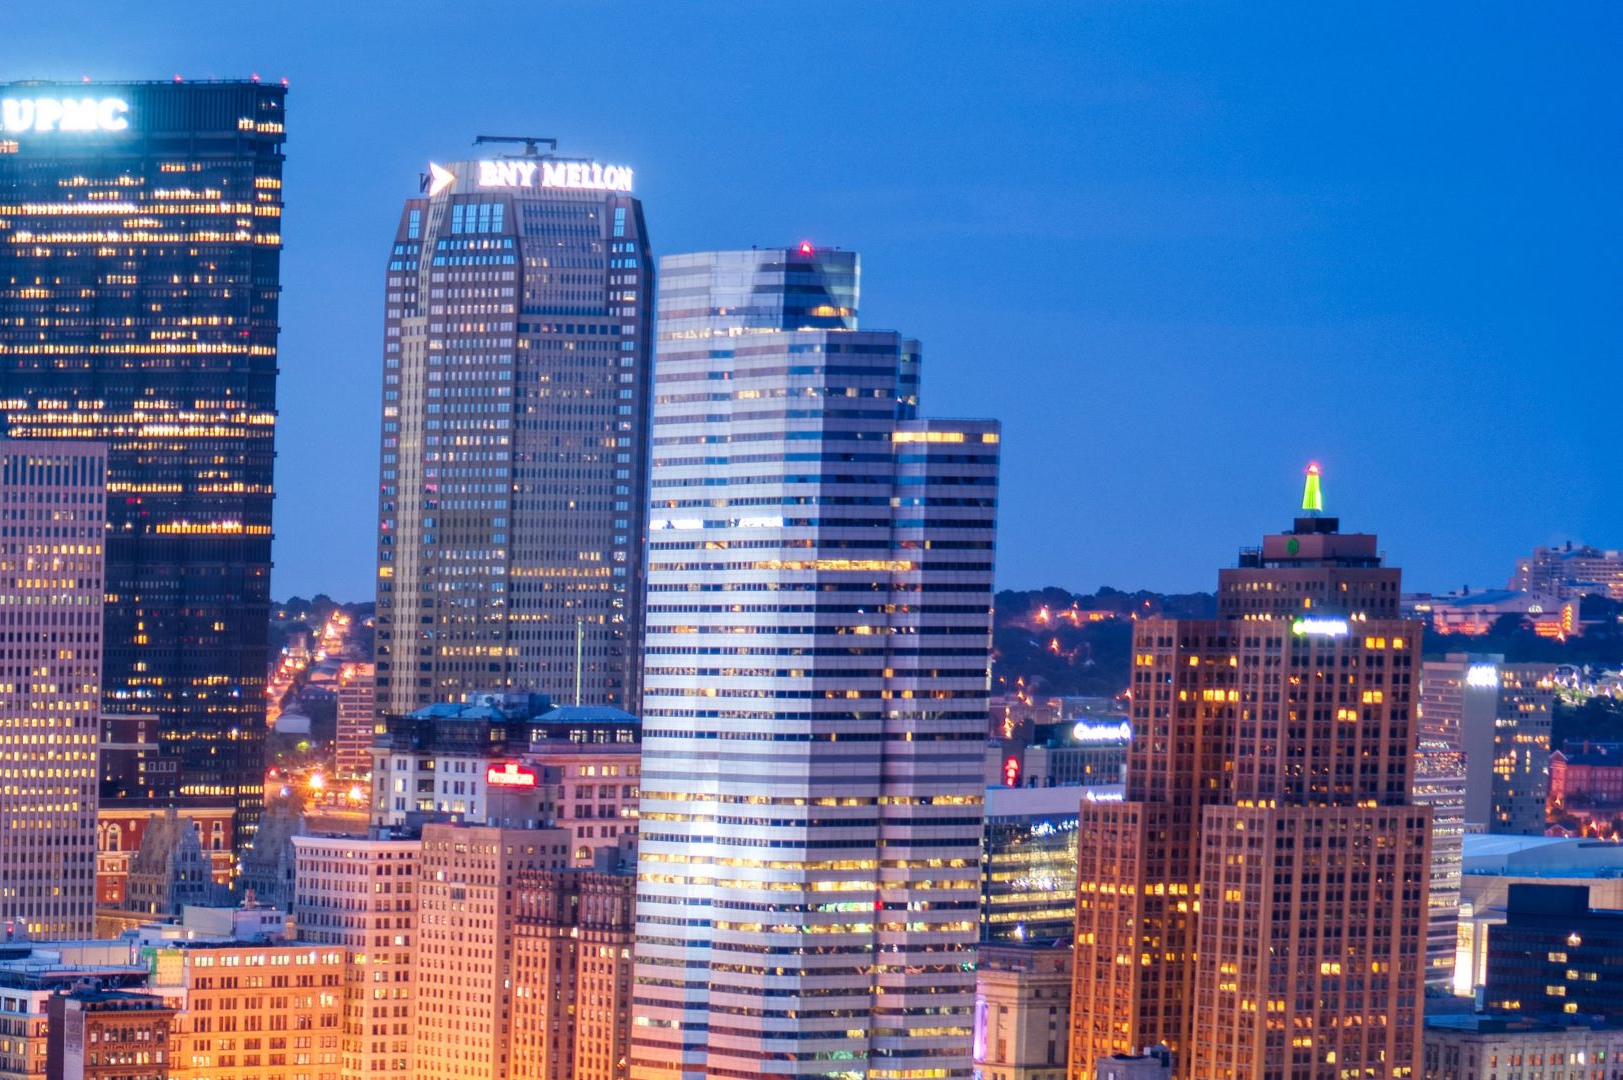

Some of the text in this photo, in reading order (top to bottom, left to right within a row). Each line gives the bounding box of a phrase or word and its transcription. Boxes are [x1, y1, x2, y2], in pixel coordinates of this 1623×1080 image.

[3, 98, 128, 132] UPMC
[478, 160, 635, 191] BNY MELLON
